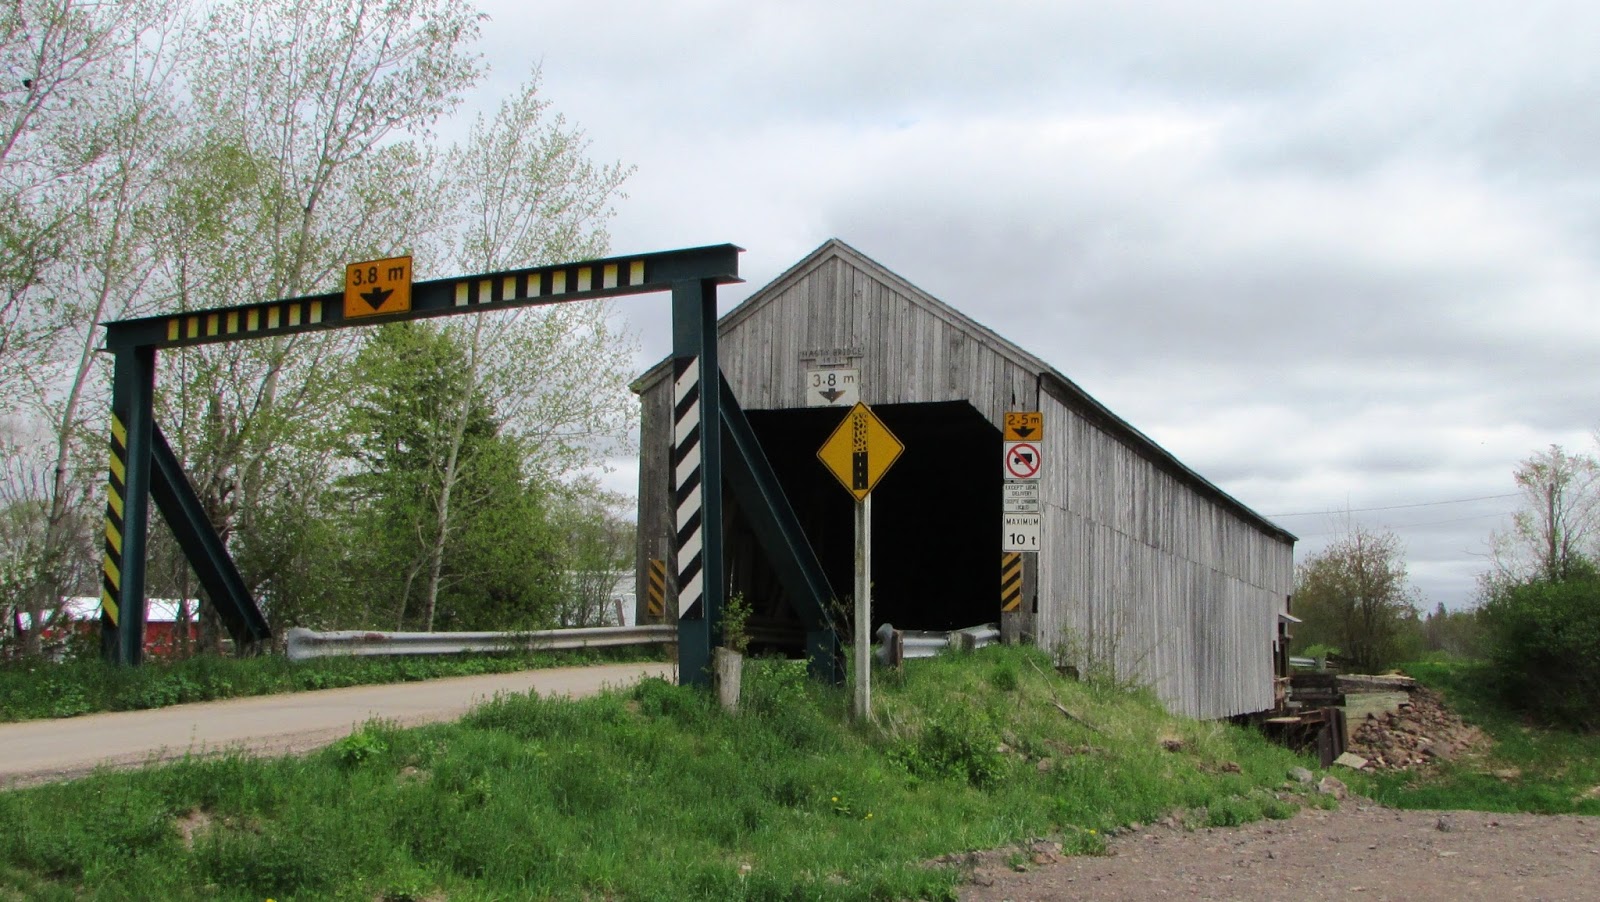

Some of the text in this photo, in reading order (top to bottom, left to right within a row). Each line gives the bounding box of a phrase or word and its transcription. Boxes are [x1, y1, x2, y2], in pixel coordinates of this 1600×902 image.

[352, 266, 405, 286] 3.8 m
[843, 375, 854, 384] m
[1008, 414, 1029, 426] 2.5
[1006, 518, 1039, 526] MAXIMUM
[1009, 533, 1036, 546] 10 t
